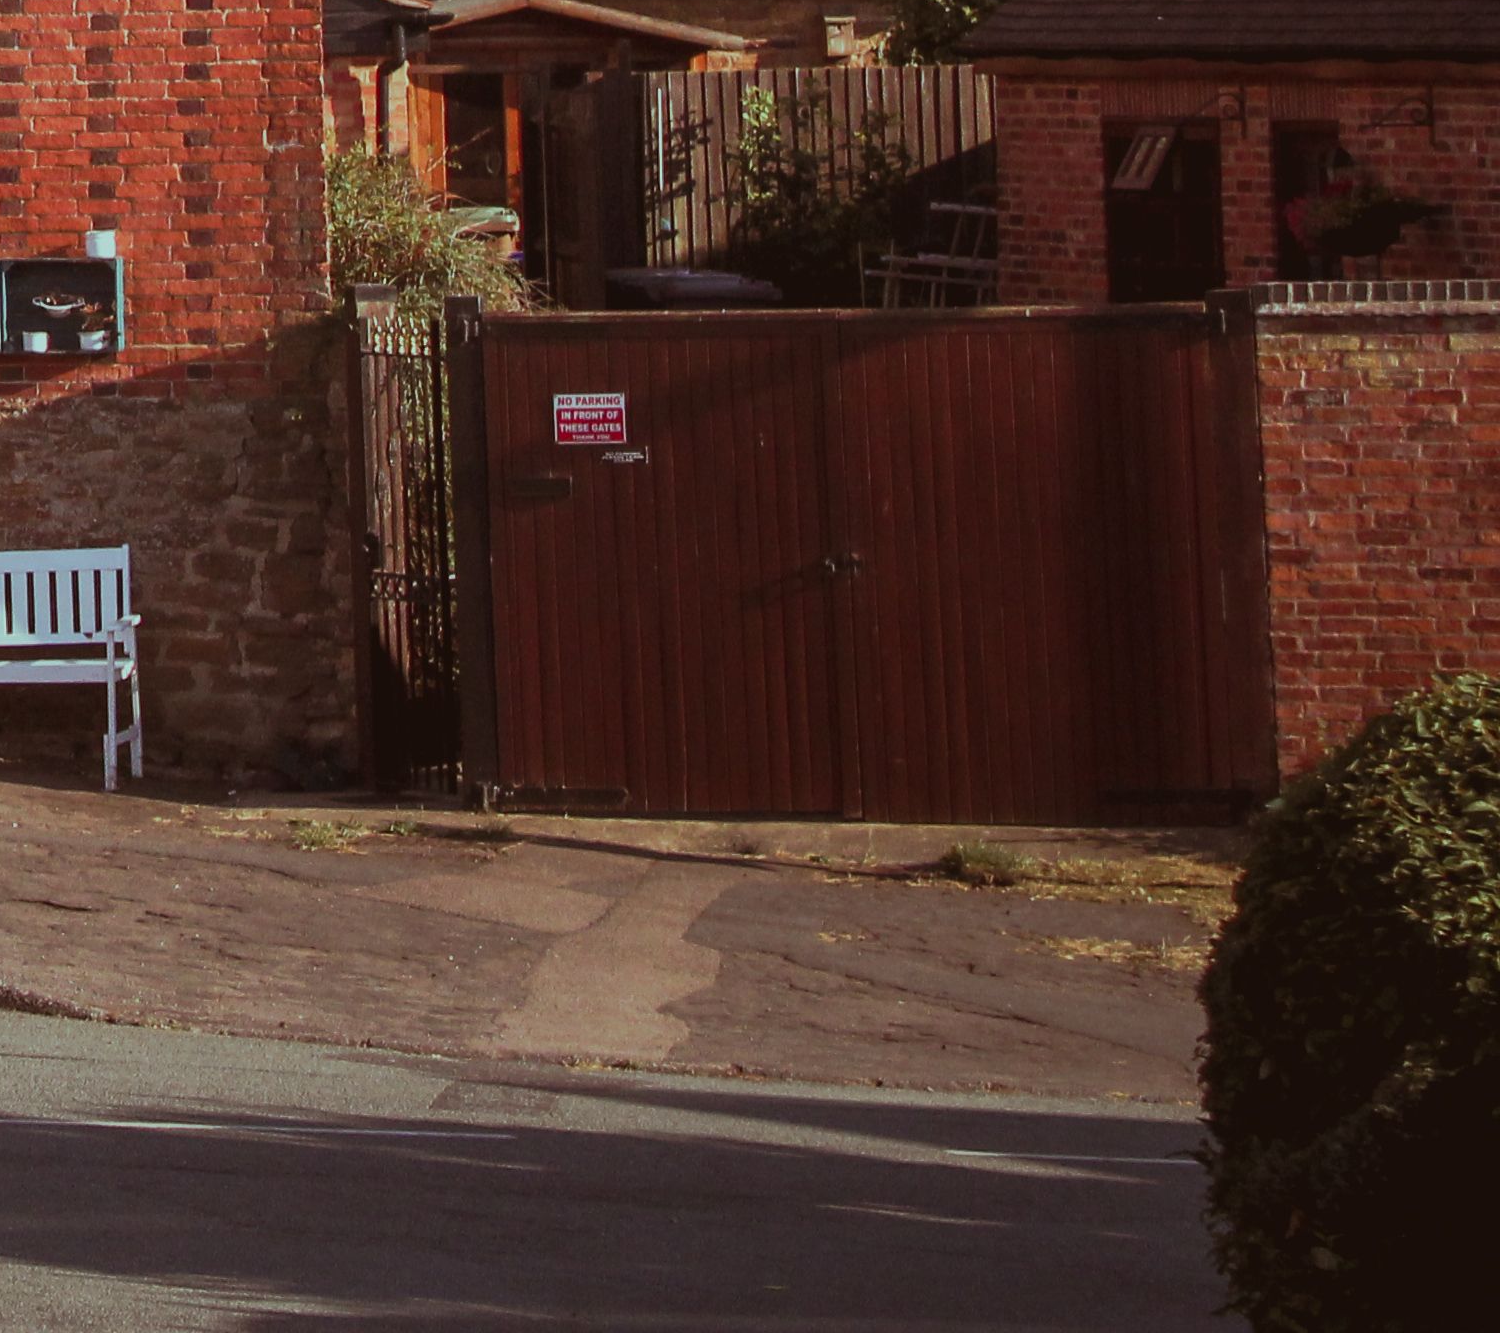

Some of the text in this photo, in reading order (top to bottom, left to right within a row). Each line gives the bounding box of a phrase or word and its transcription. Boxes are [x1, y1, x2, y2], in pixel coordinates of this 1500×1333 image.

[558, 396, 621, 406] NO PARKING
[561, 410, 619, 421] IN FRONT OF
[560, 422, 621, 433] THESE GATES
